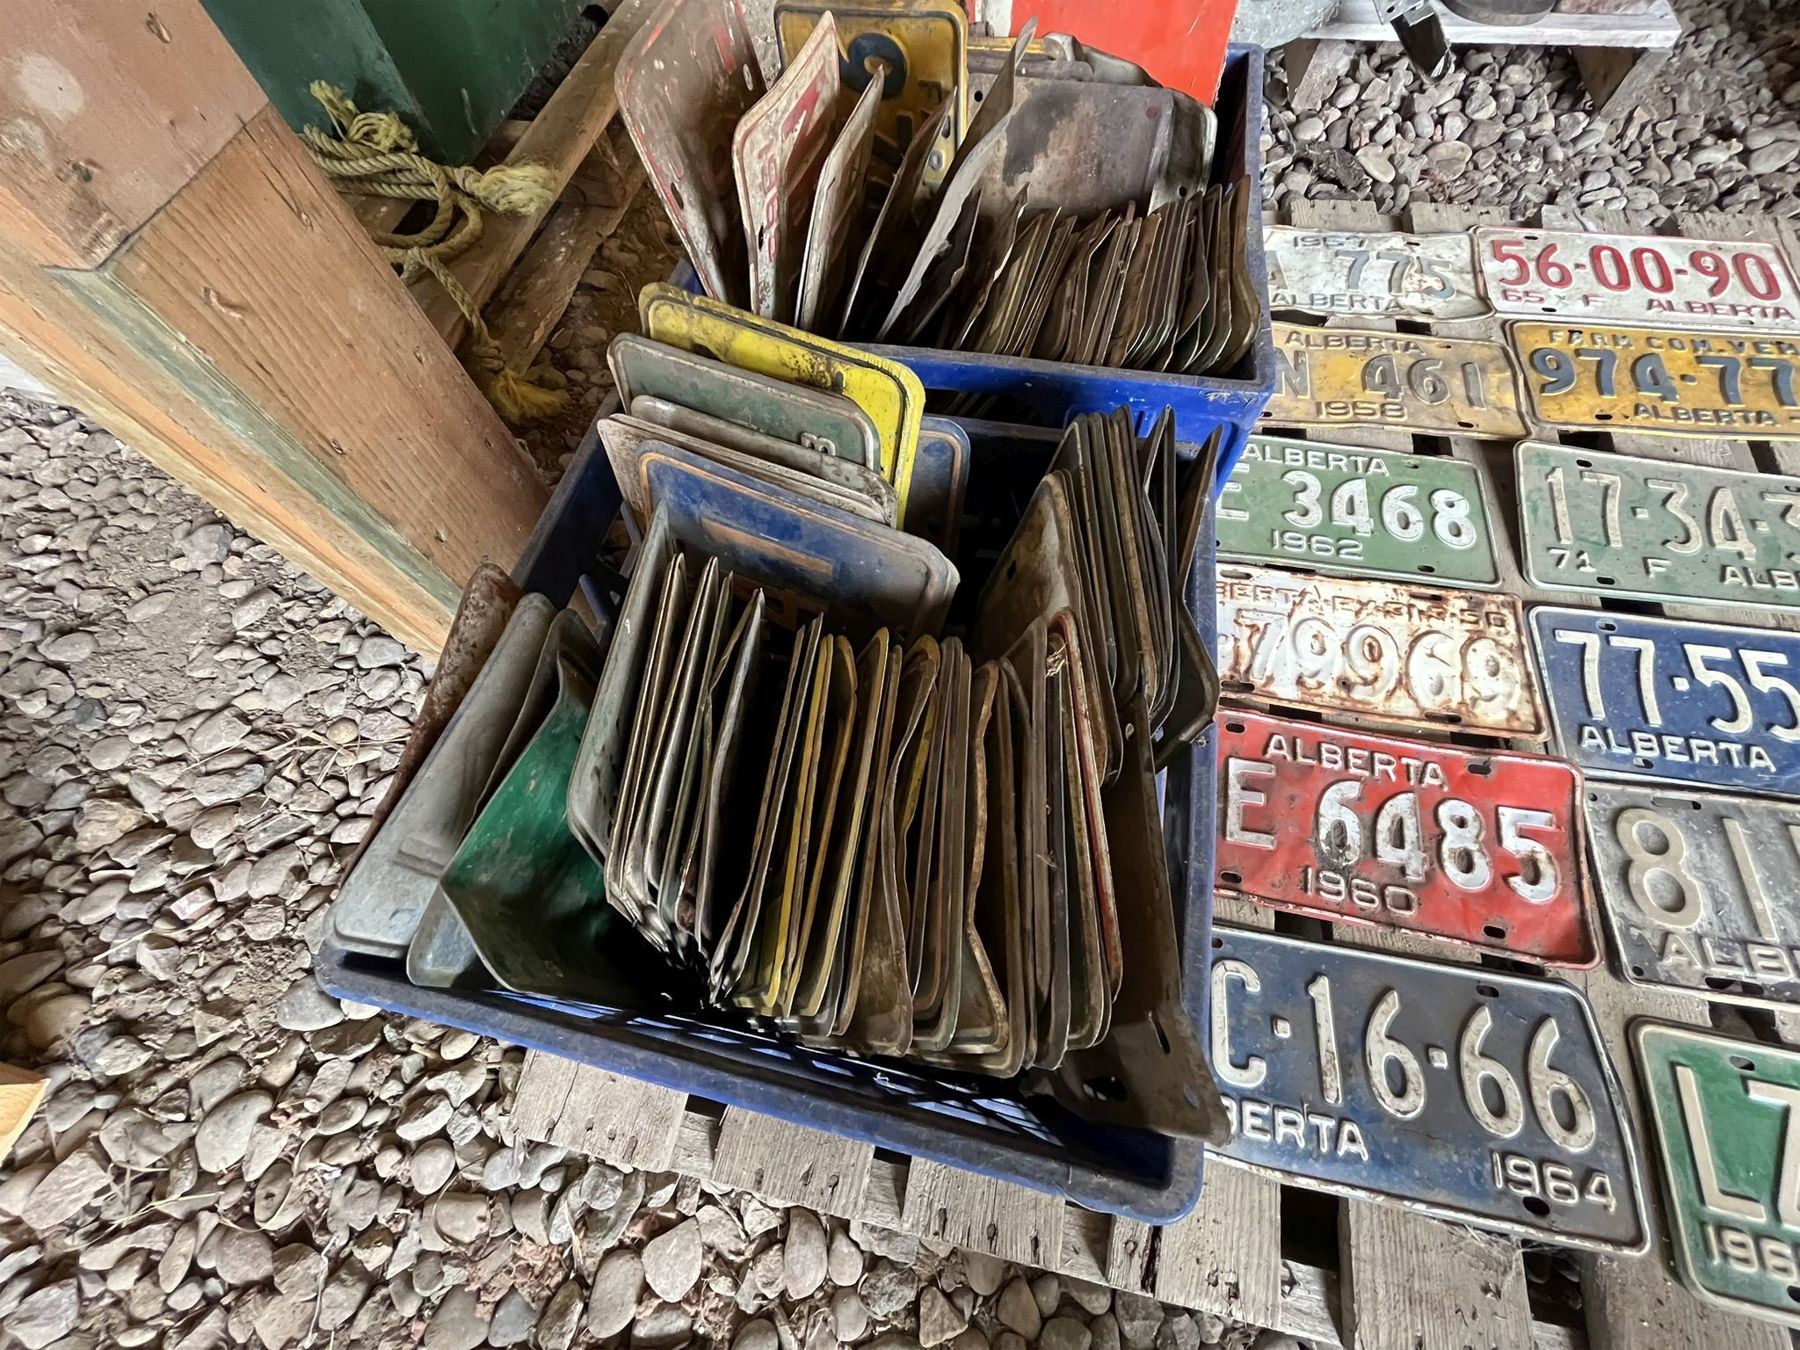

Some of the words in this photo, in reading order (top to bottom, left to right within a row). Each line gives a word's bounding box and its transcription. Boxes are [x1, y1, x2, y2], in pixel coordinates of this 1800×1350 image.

[1491, 240, 1781, 301] 56-00-90
[1271, 292, 1402, 312] ALBERTA
[1647, 298, 1796, 320] ALBERTA
[1285, 330, 1426, 356] ALBERTA
[1549, 329, 1634, 350] FARM
[1361, 352, 1488, 411] 461
[1315, 400, 1409, 421] 1958
[1634, 402, 1781, 428] ALBERTA
[1240, 443, 1391, 478] ALBERTA
[1281, 469, 1477, 550] 3468
[1271, 528, 1365, 560] 1962
[1547, 547, 1598, 573] 71
[1645, 557, 1672, 579] F
[1721, 565, 1800, 592] ALB
[1264, 733, 1449, 792] ALBERTA
[1580, 725, 1777, 773] ALBERTA
[1224, 757, 1277, 850] E
[1315, 779, 1566, 904] 6485
[1303, 866, 1418, 917] 1960
[1612, 806, 1800, 944] 81
[1660, 931, 1800, 981] ALB
[1491, 1150, 1618, 1214] 1964
[1702, 1222, 1800, 1284] 196
